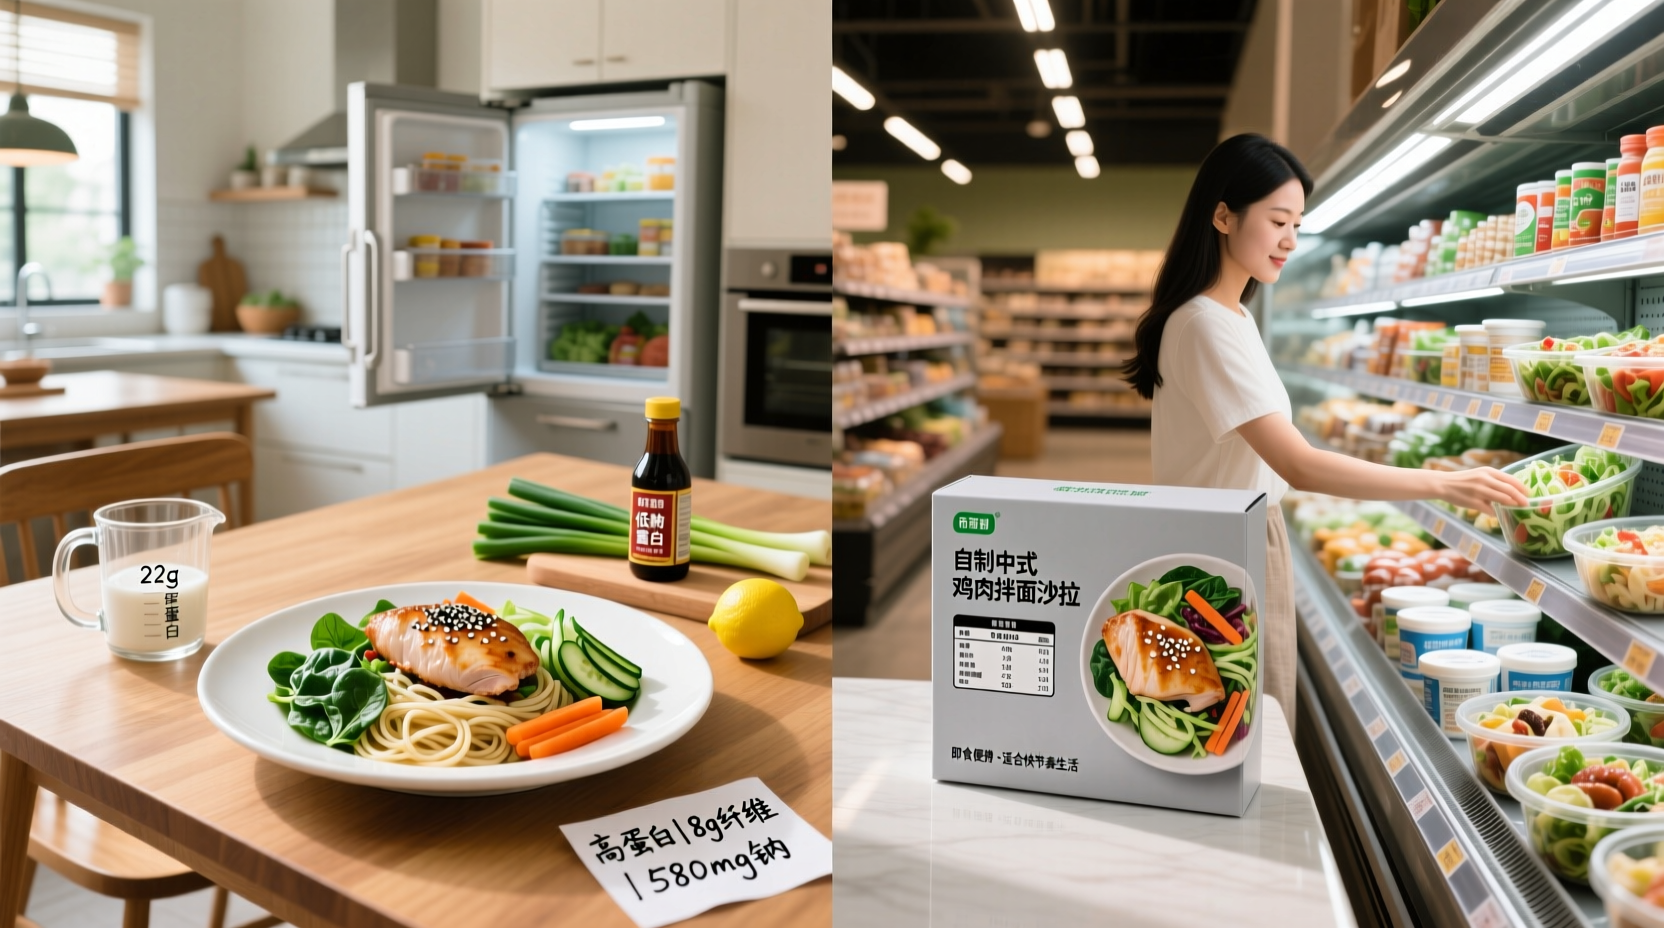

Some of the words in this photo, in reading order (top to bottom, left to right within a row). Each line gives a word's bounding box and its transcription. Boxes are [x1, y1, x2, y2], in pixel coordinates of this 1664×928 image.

[140, 564, 179, 589] 22g
[955, 547, 1038, 577] 自制中式
[952, 575, 1081, 607] 鸡肉拌面沙拉
